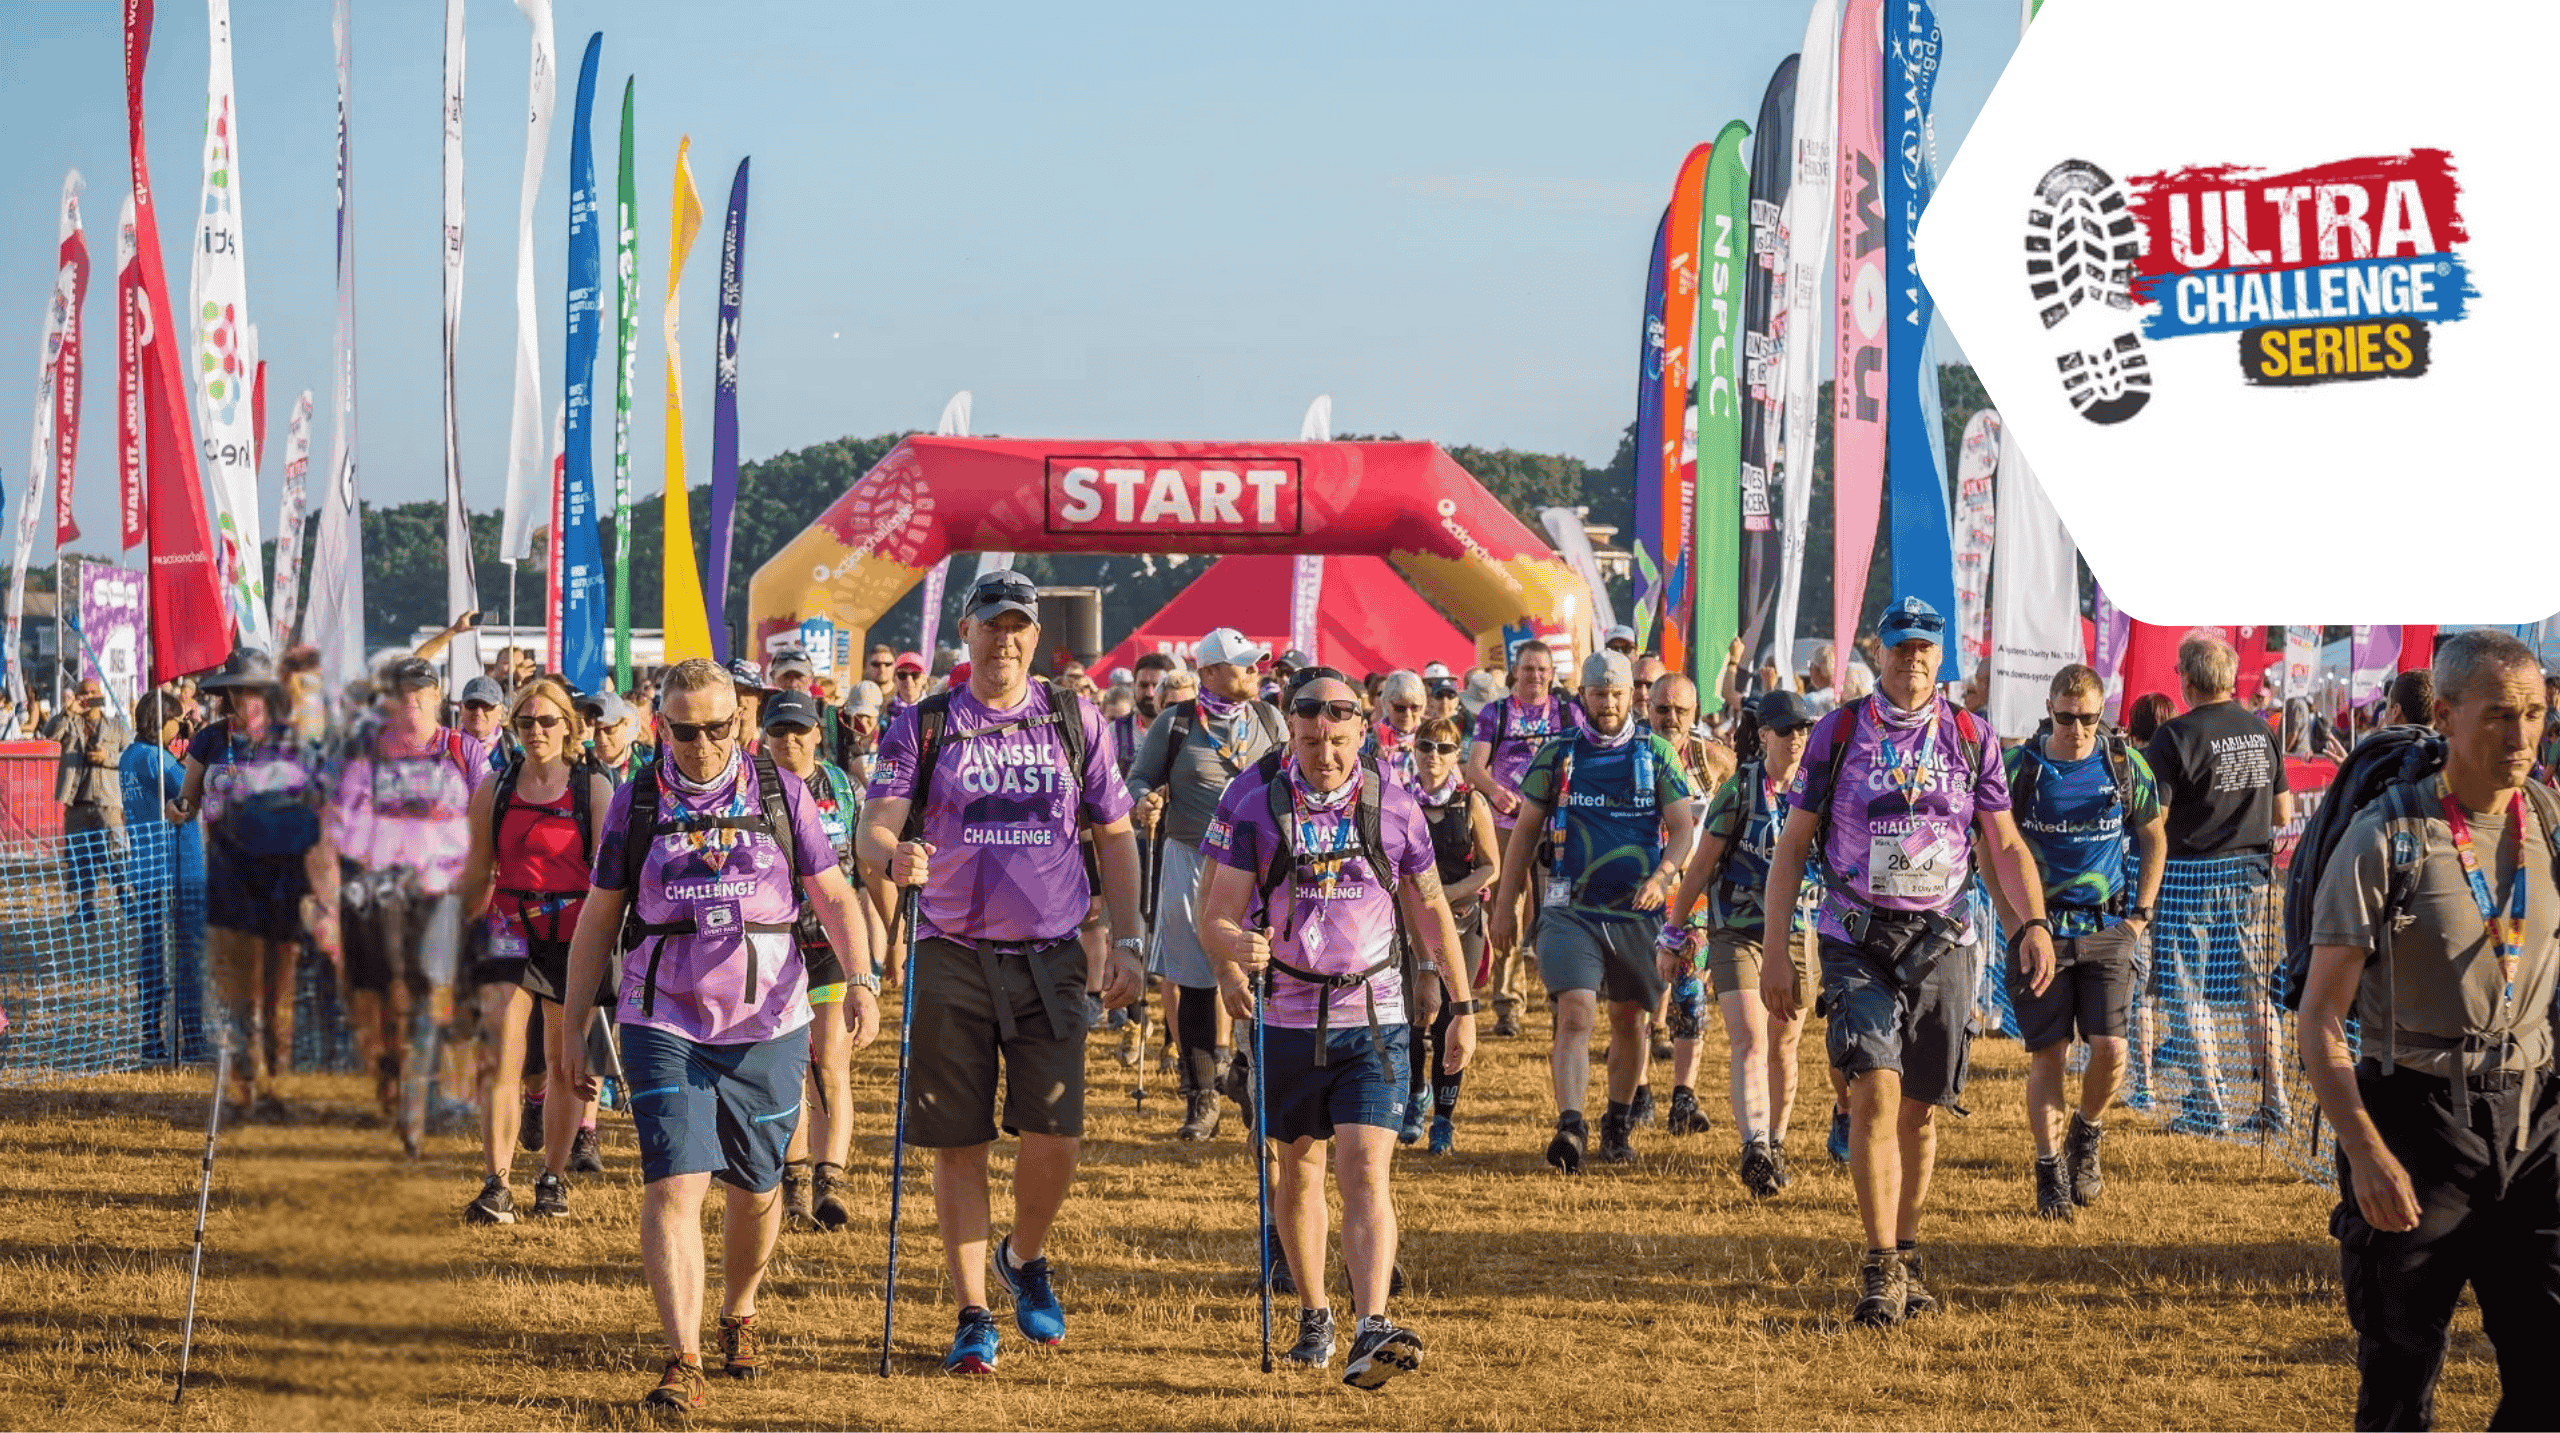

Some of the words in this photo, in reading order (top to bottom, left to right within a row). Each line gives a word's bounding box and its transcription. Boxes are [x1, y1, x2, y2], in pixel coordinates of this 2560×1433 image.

[1843, 143, 1854, 284] cancer
[1710, 214, 1732, 417] NSPCC
[1840, 293, 1852, 419] breast
[58, 458, 73, 529] WALK
[126, 467, 140, 534] WALK
[1061, 467, 1288, 524] START
[2210, 734, 2268, 755] MARILLION
[962, 766, 1056, 794] COAST
[963, 827, 1052, 846] CHALLENGE
[664, 881, 756, 901] CHALLENGE
